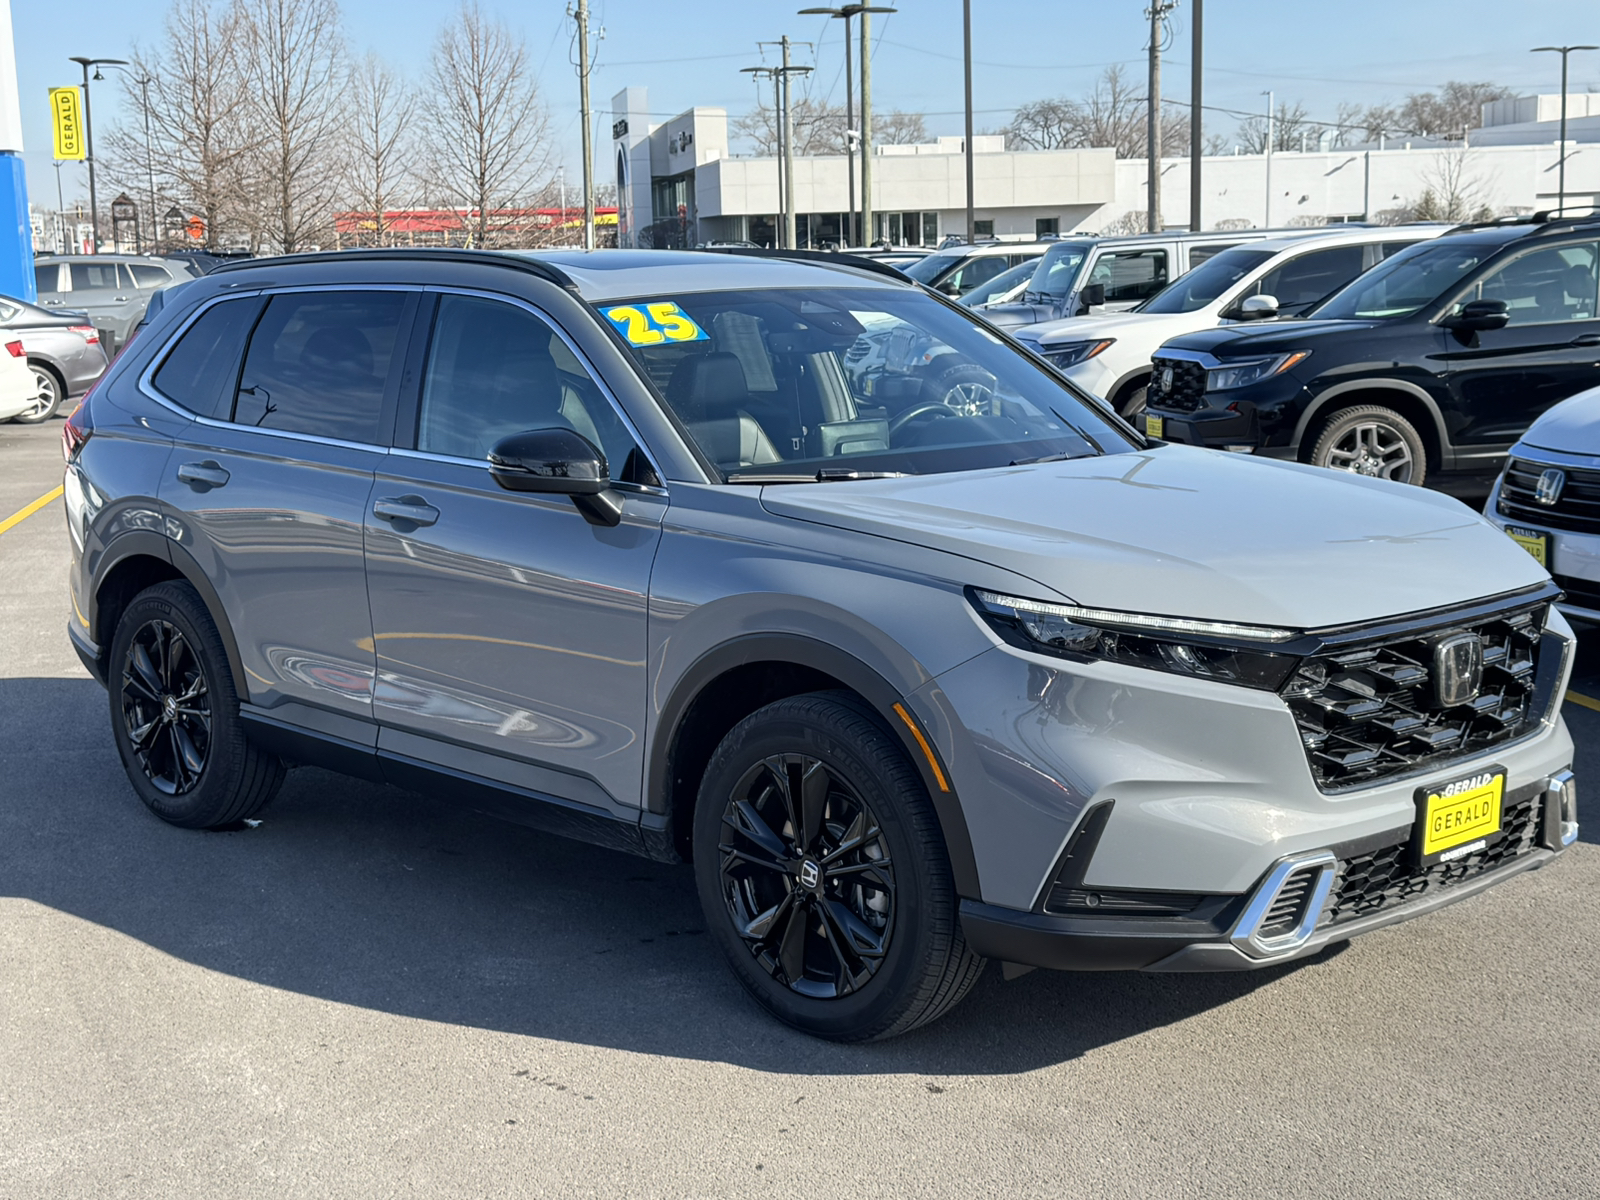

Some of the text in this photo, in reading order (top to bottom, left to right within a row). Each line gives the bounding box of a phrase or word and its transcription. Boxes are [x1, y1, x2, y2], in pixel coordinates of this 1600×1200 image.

[61, 96, 75, 150] GERALD
[607, 303, 699, 345] 25
[832, 746, 892, 819] MICHELIN
[1445, 773, 1492, 797] GERALD
[1434, 801, 1490, 832] GERALD
